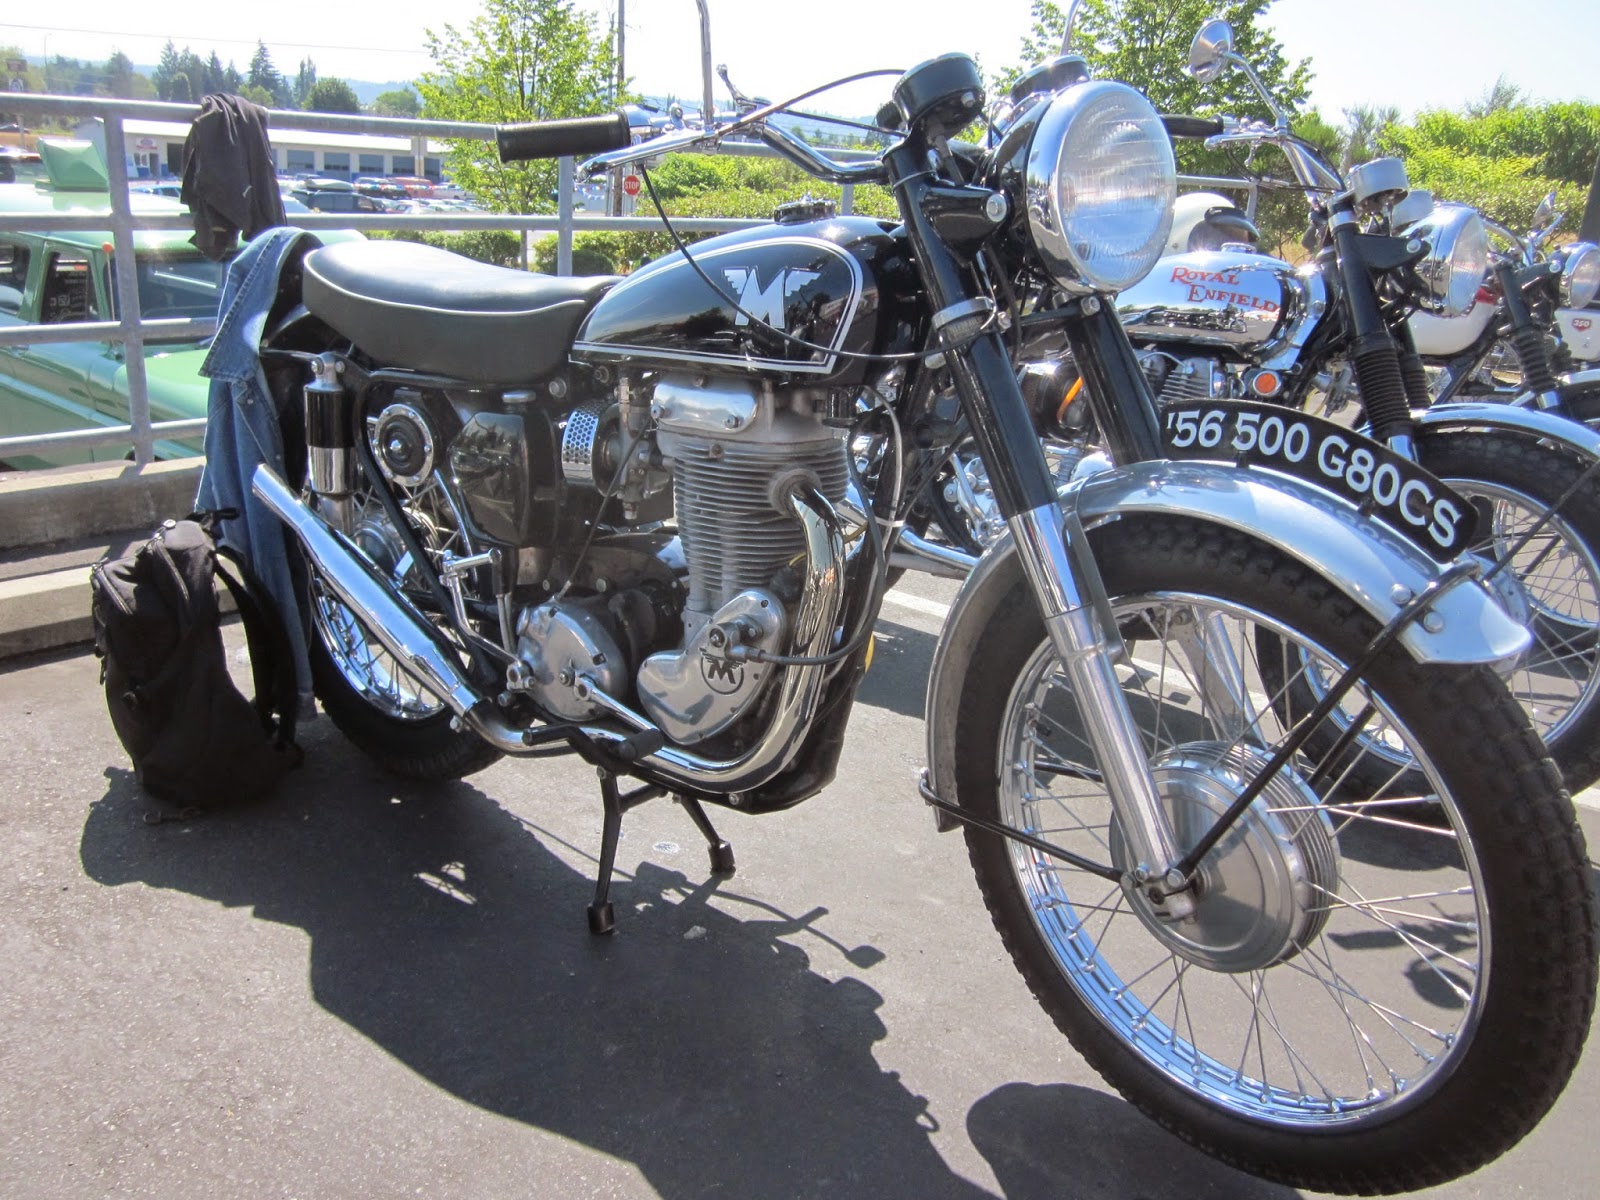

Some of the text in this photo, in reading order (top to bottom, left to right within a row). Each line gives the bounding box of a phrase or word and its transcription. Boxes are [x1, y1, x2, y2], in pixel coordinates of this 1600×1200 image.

[624, 181, 640, 190] STOP
[1573, 319, 1591, 328] 350
[1231, 410, 1311, 464] 500
[1317, 434, 1463, 549] G80CS
